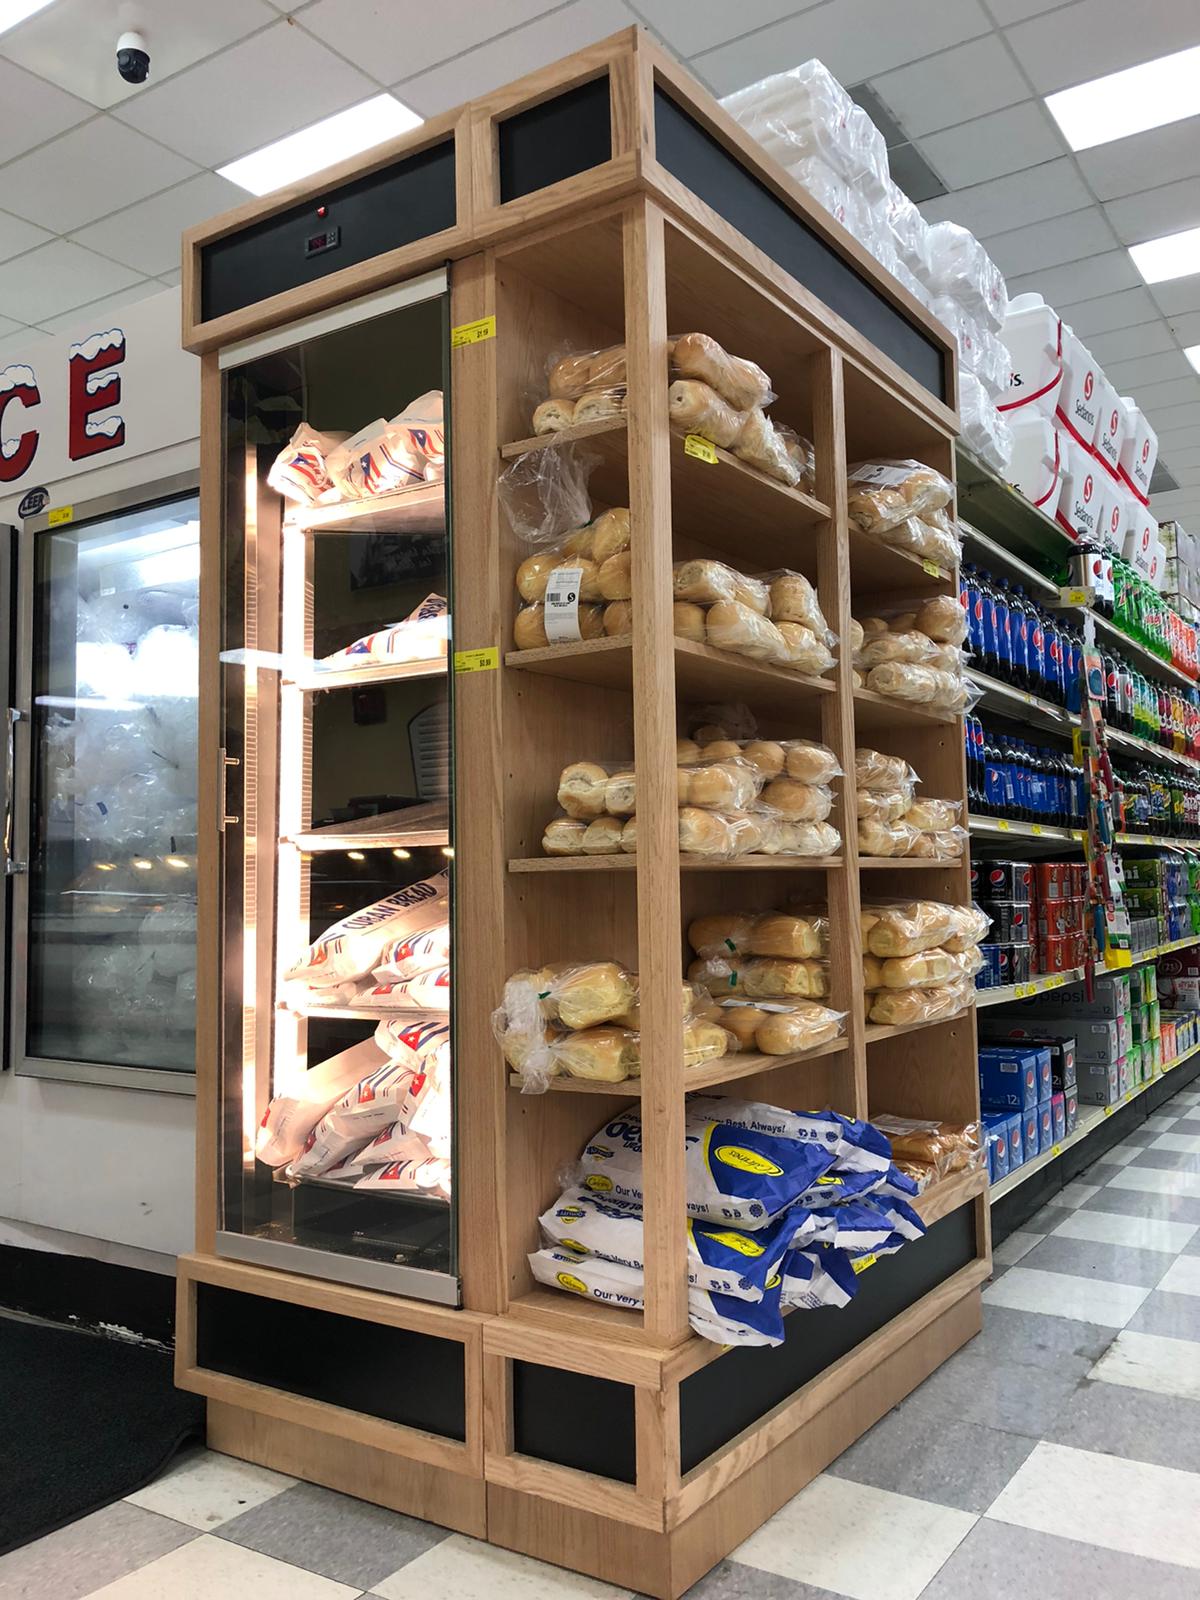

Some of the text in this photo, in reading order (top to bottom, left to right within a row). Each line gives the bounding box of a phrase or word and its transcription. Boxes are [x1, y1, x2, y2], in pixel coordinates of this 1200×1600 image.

[0, 328, 126, 483] CE
[342, 882, 438, 930] CUBAN BREAD
[750, 1121, 786, 1134] Always!
[615, 1184, 643, 1200] Our Ve
[593, 1287, 640, 1307] Our Very
